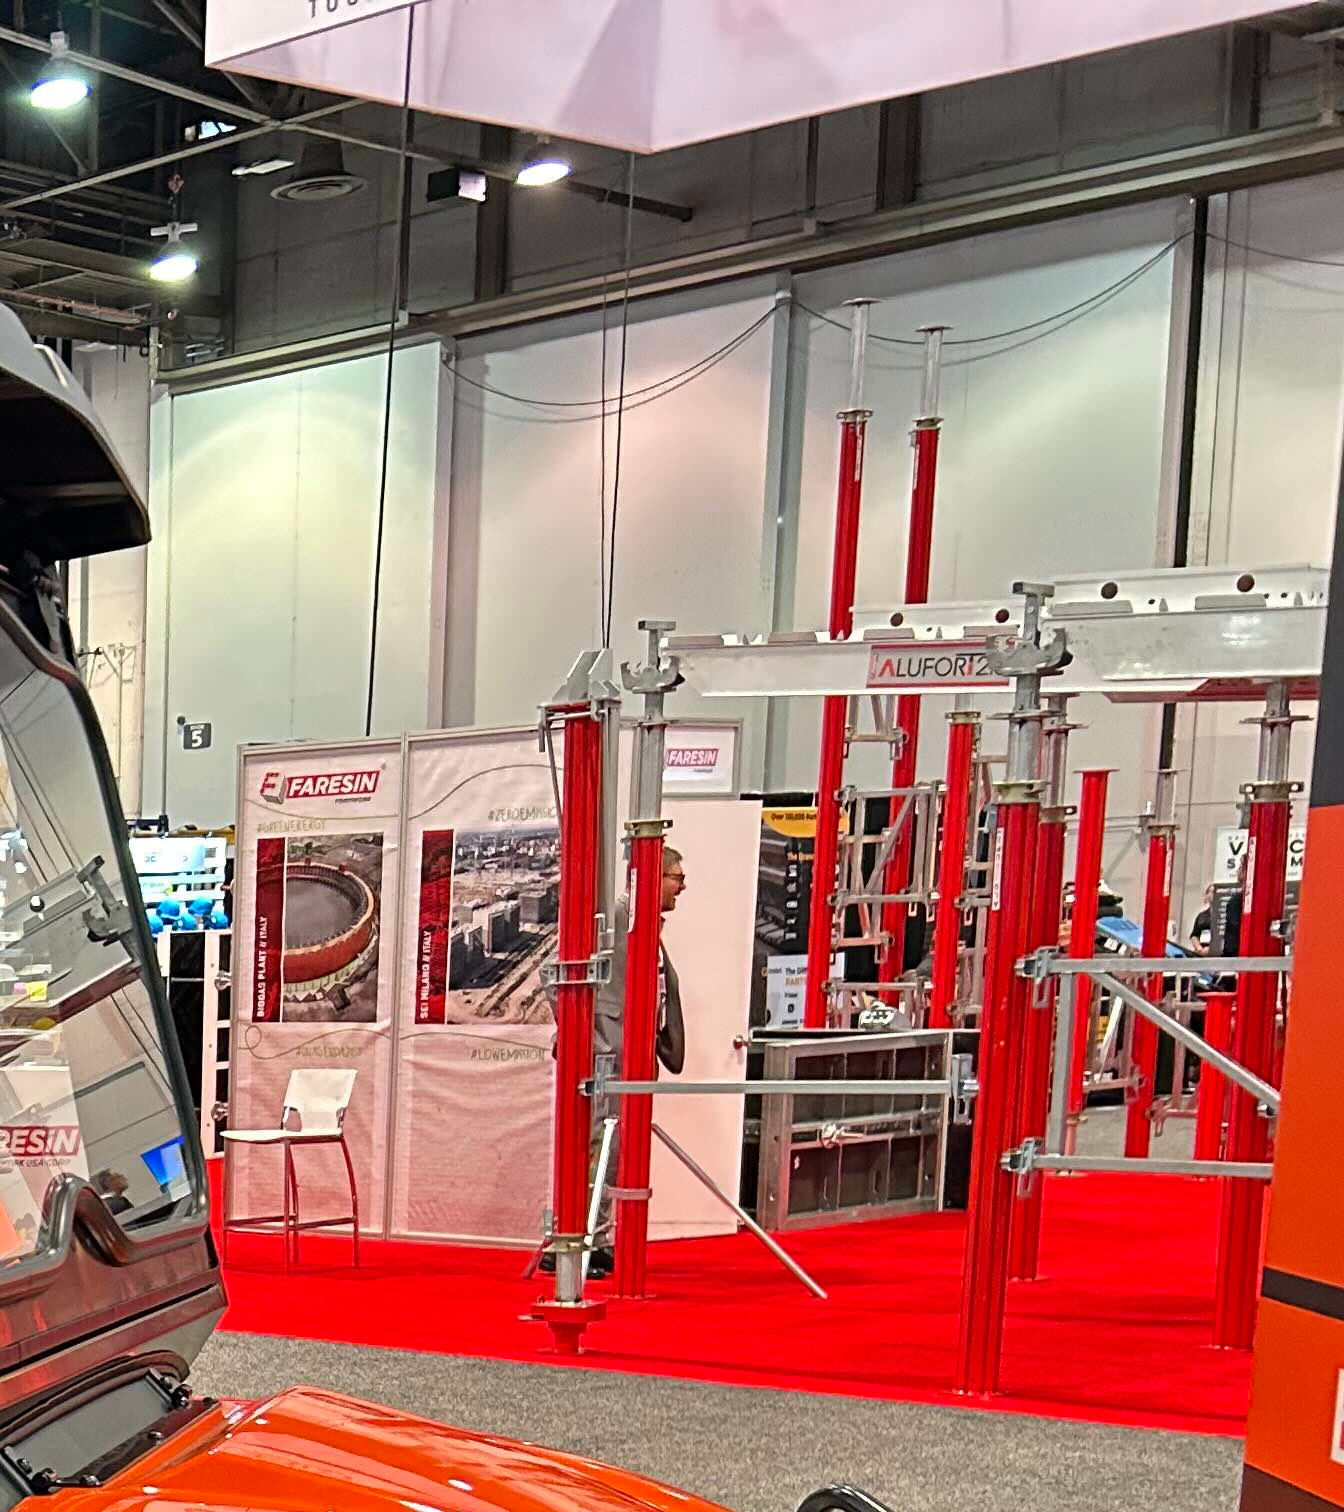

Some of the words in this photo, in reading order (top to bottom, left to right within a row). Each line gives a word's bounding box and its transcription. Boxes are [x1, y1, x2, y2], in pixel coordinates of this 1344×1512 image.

[190, 730, 203, 748] 5
[668, 750, 717, 765] FARESIN
[288, 772, 378, 797] FARESIN
[259, 916, 268, 939] ITALY
[258, 949, 267, 980] PLANT
